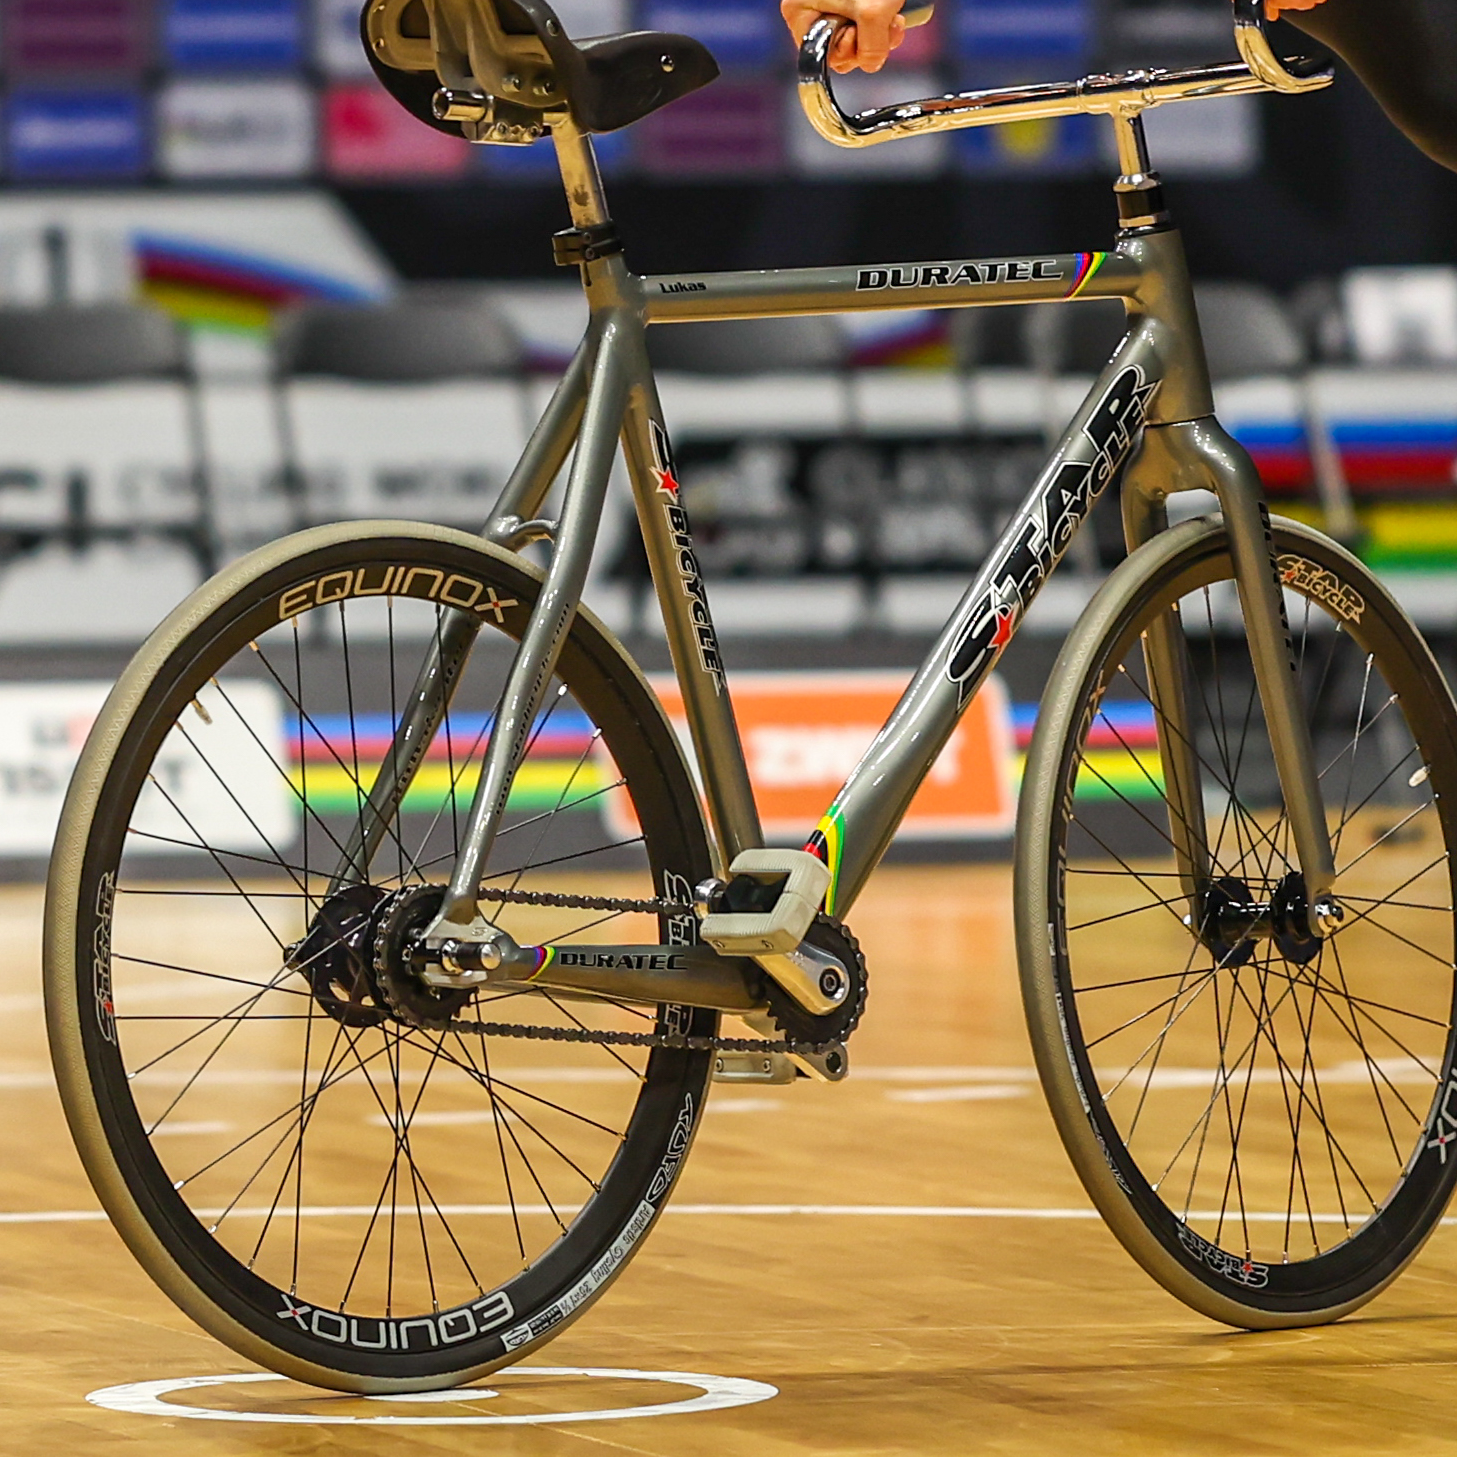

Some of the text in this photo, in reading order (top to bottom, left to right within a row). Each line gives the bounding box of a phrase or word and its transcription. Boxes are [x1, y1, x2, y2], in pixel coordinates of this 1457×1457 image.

[658, 280, 707, 294] Lukas
[855, 259, 1064, 291] DURATEC
[278, 565, 519, 624] EQUINOX
[663, 503, 722, 675] BICYCLE
[1293, 570, 1355, 621] BICYCLE
[559, 951, 689, 971] DURATEC
[646, 1092, 694, 1203] TUFO
[275, 1290, 515, 1350] EQUINOX
